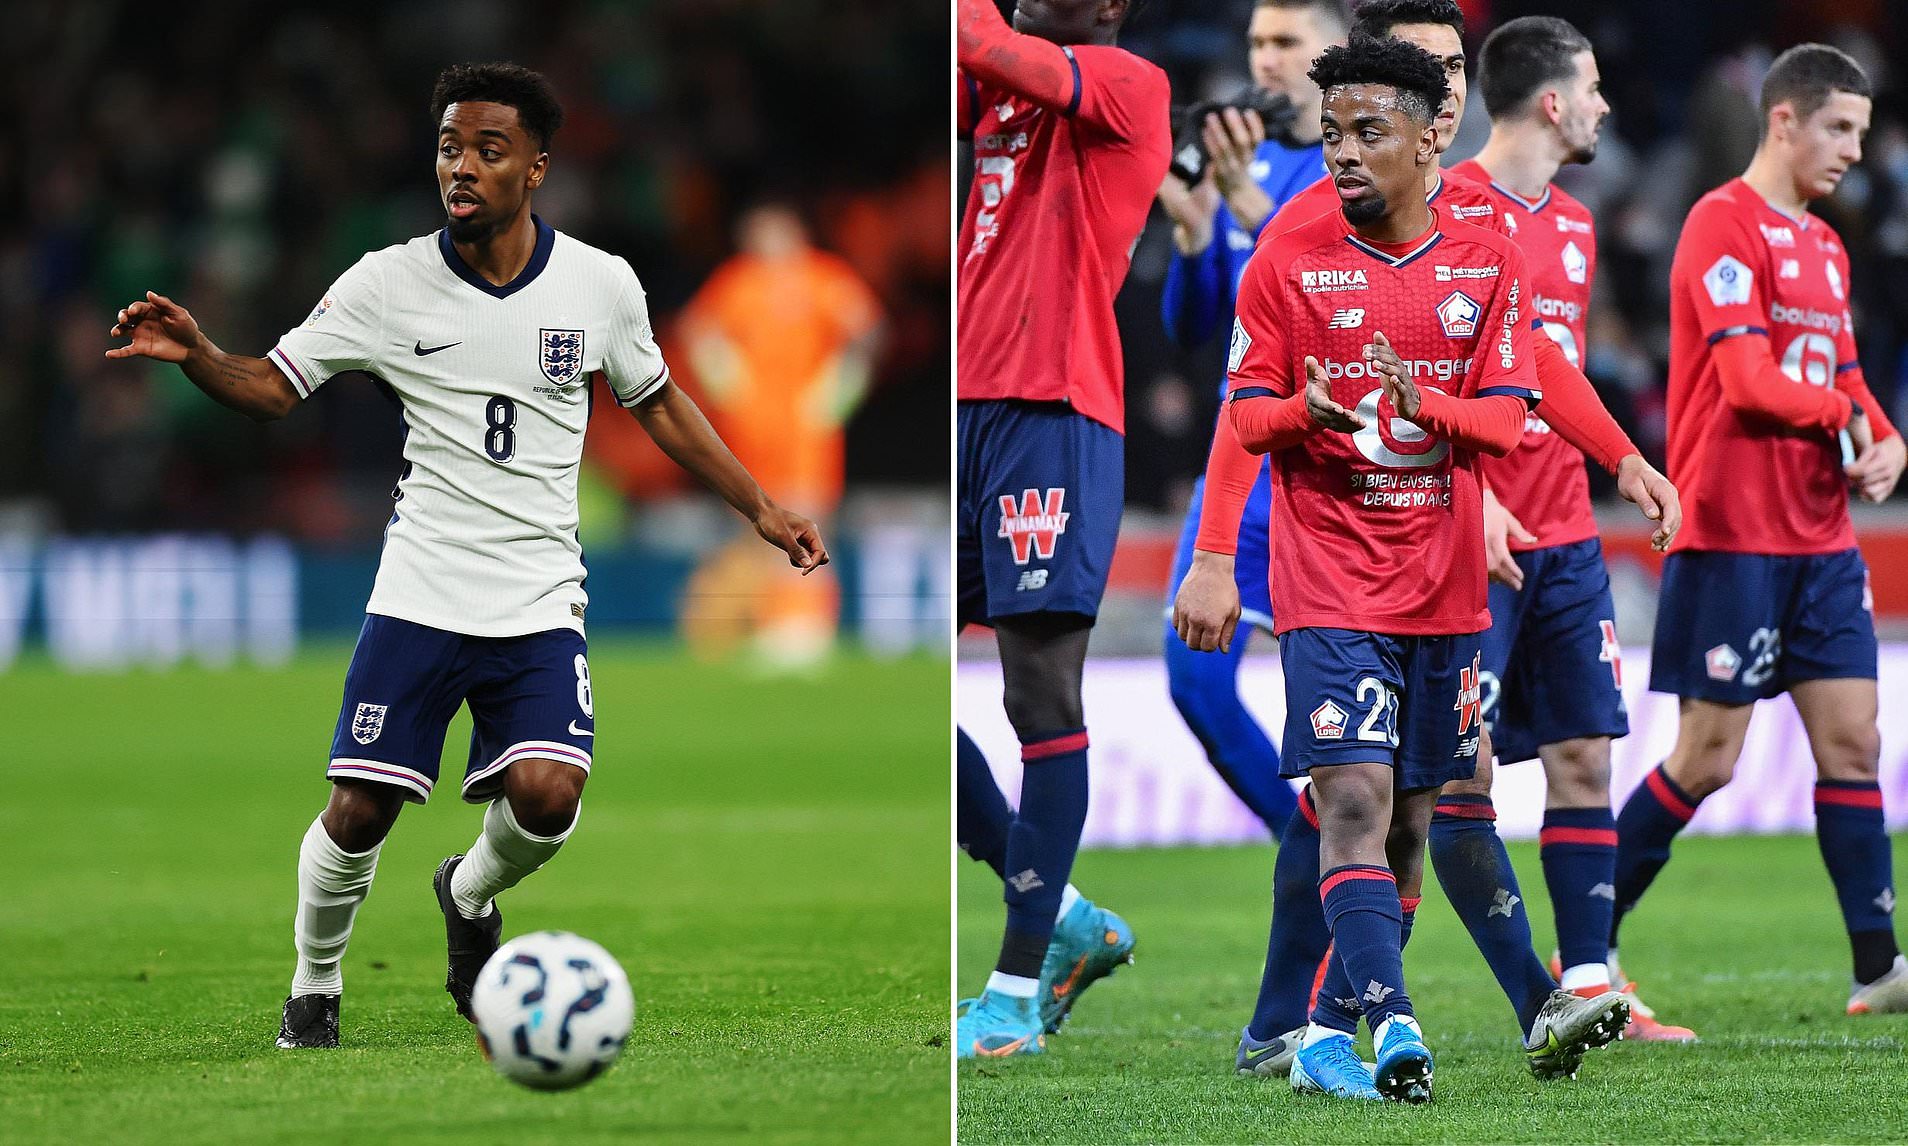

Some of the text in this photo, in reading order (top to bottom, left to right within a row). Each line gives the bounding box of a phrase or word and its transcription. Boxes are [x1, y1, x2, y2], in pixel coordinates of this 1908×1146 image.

[1318, 269, 1368, 285] RIKA
[1449, 324, 1471, 333] LOSC
[1325, 358, 1473, 381] bounger
[484, 396, 518, 464] 8
[1365, 474, 1398, 489] BIEN
[1363, 492, 1451, 507] DEPUIS 10 ANS
[574, 653, 594, 720] 8
